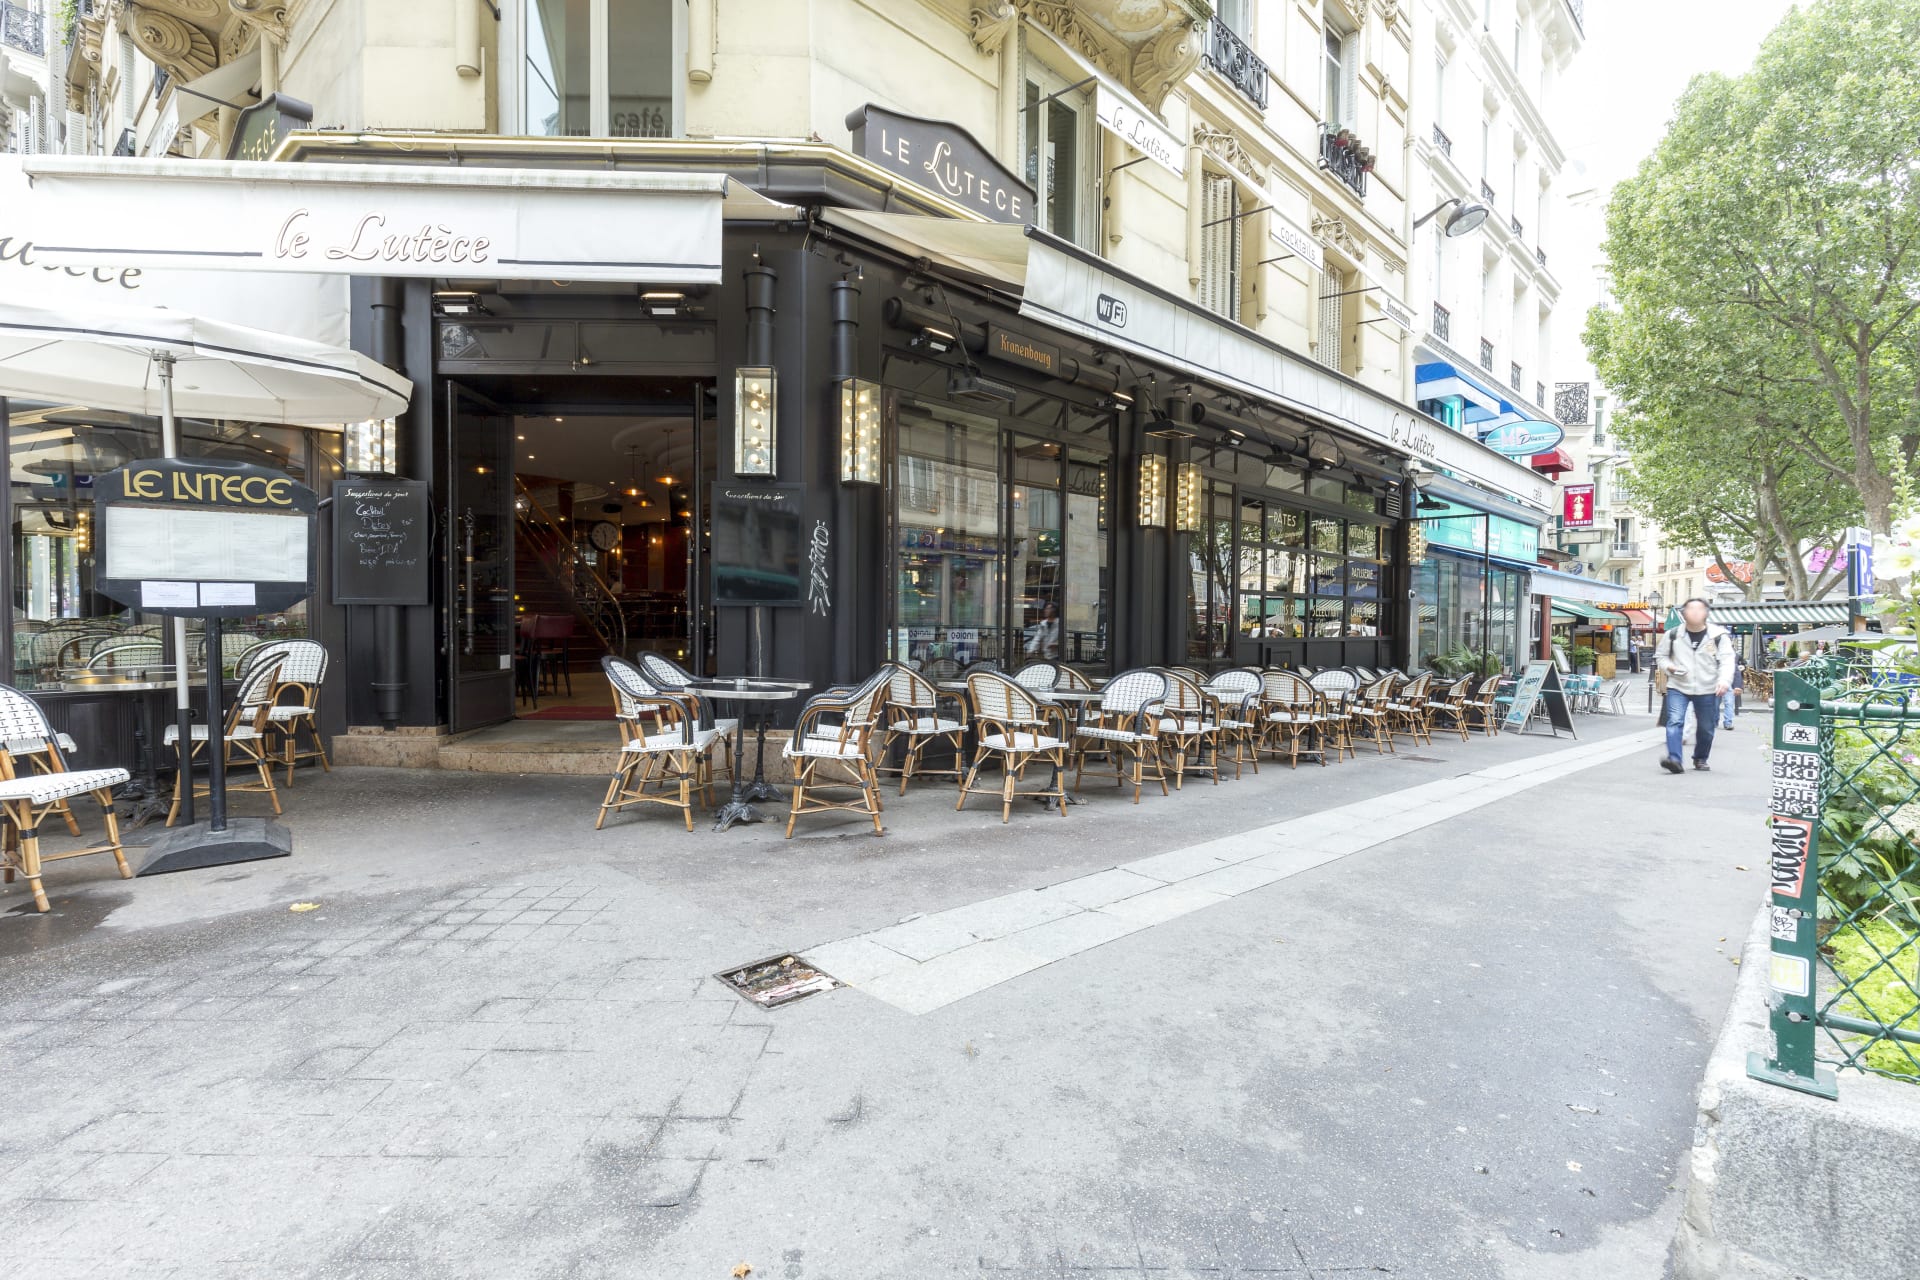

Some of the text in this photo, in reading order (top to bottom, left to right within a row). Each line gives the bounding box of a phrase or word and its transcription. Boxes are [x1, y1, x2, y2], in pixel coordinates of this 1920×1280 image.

[613, 106, 664, 128] café
[882, 128, 910, 165] LE
[1113, 106, 1170, 164] le Lutèce
[274, 208, 490, 263] le Lutèce
[1280, 226, 1316, 260] cocktails
[1001, 334, 1051, 369] Kronenbourg
[1391, 412, 1435, 458] le Lutèce
[123, 468, 293, 505] LE LUTECE
[1773, 752, 1819, 767] BAR
[1773, 765, 1819, 780] SKO
[1772, 787, 1818, 802] BAR
